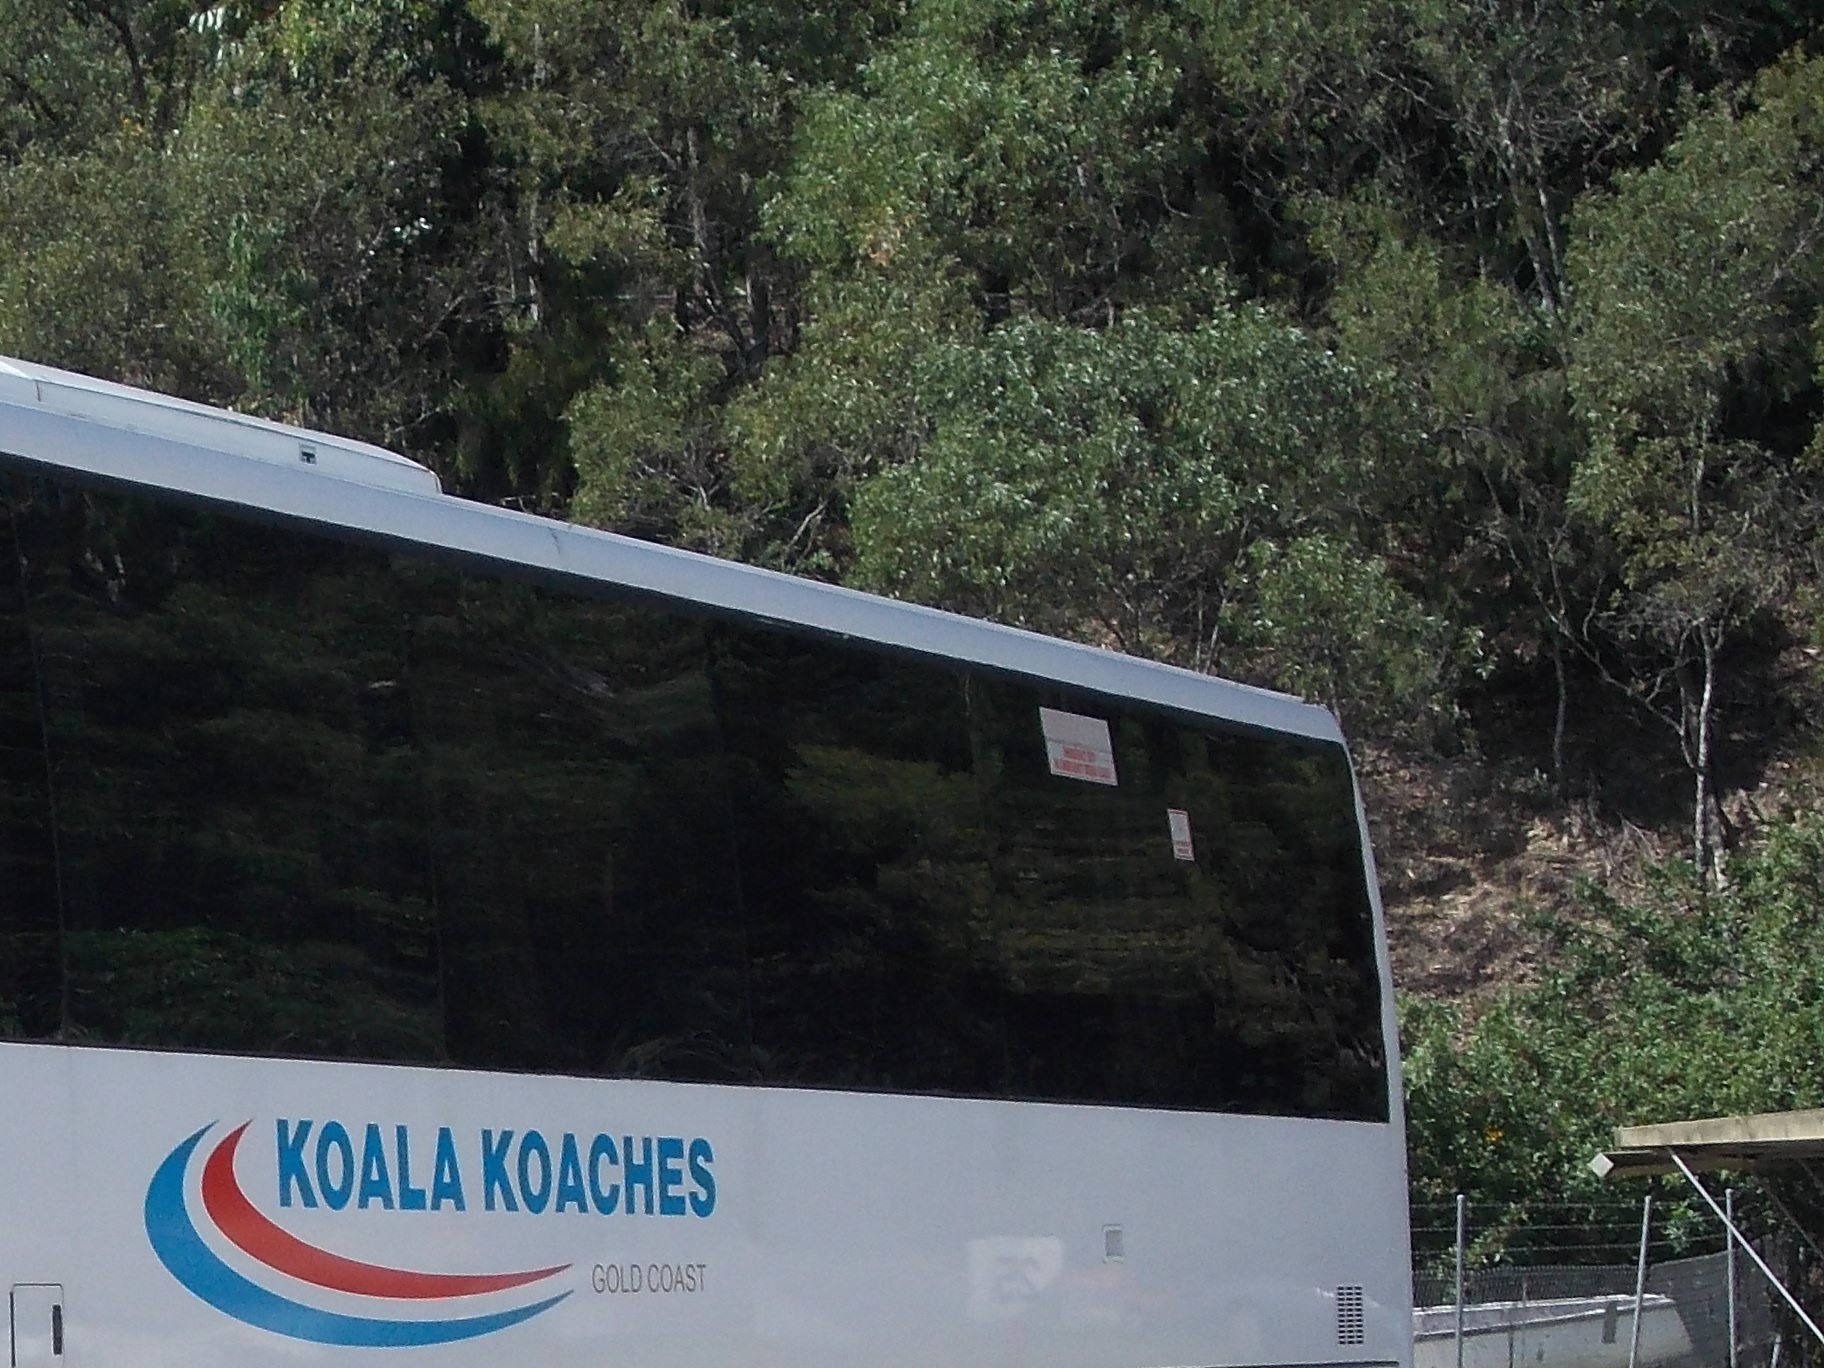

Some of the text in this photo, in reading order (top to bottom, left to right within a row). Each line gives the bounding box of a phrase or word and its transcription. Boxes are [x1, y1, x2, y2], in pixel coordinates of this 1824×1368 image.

[277, 1118, 717, 1218] KOALA KOACHES
[591, 1263, 707, 1294] GOLD COAST
